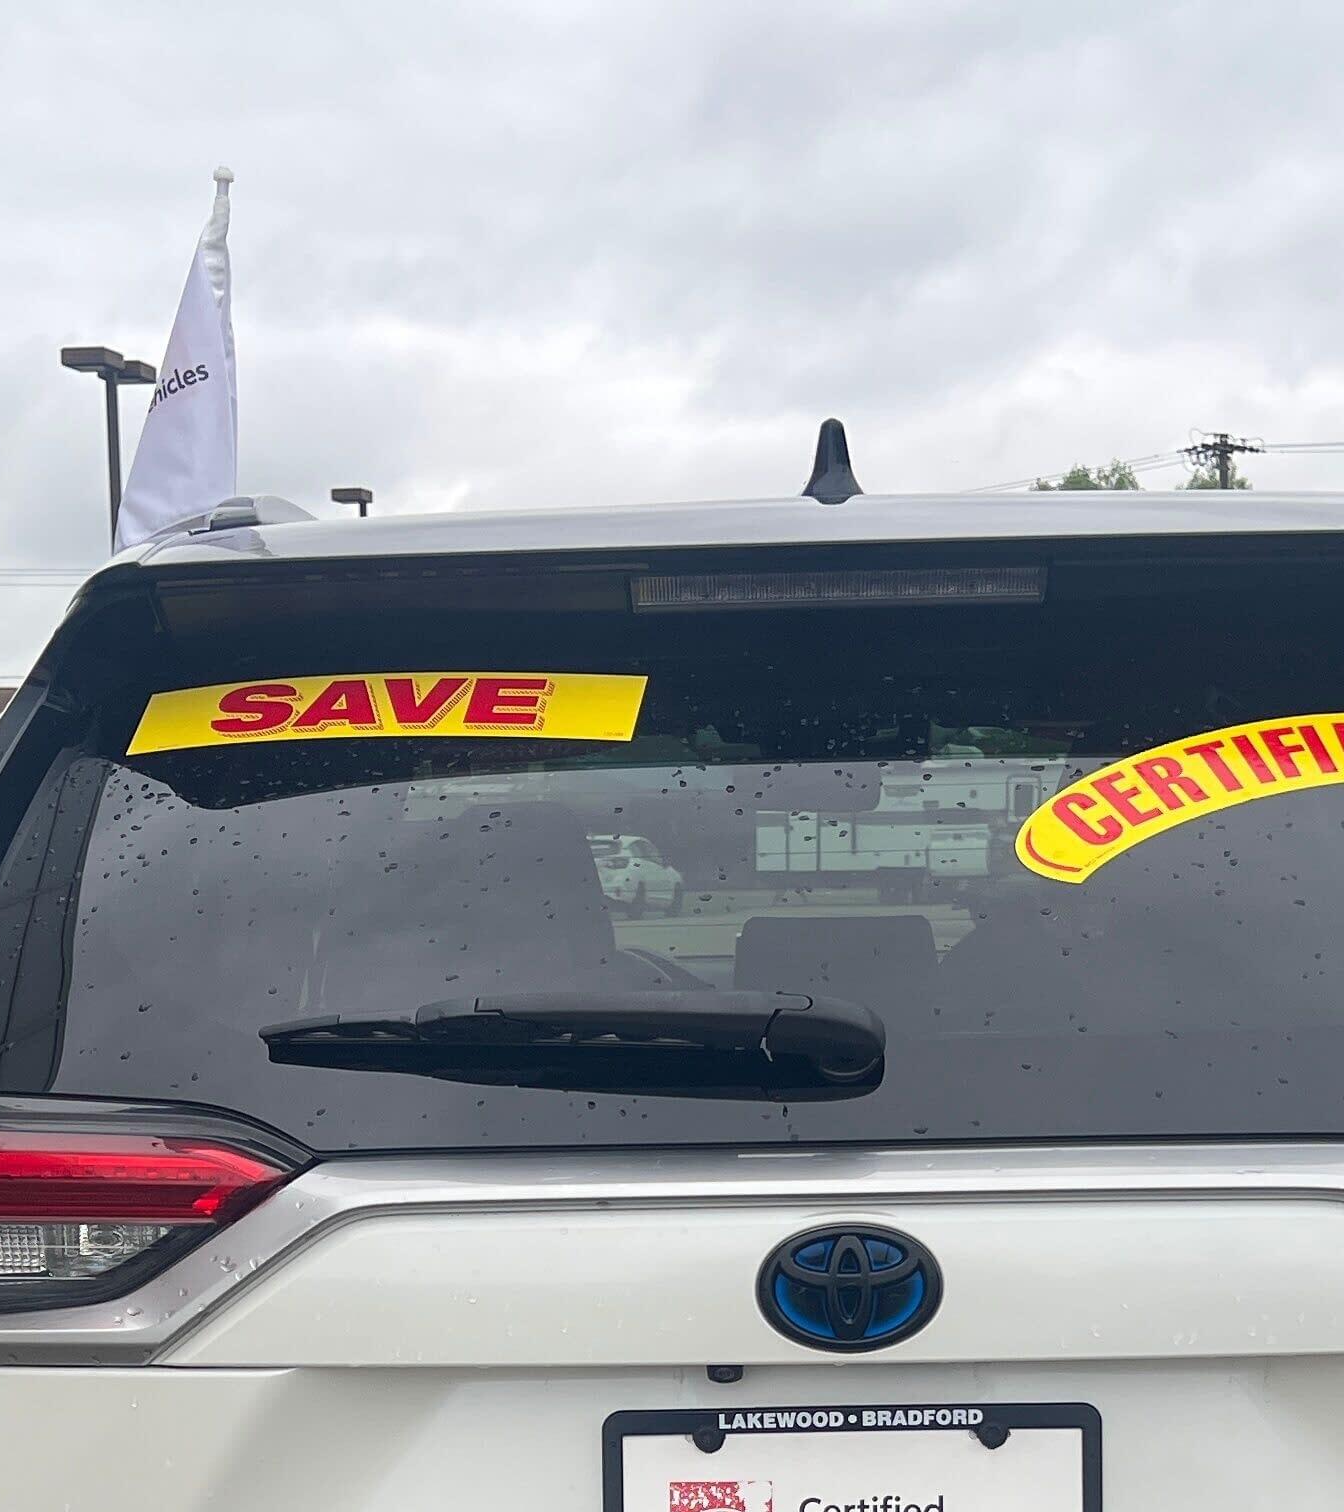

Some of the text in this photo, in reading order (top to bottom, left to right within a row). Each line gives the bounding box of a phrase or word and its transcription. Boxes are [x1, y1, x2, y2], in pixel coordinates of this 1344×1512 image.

[211, 678, 554, 738] SAVE
[718, 1408, 983, 1431] LAKEWOOD BRADFORD
